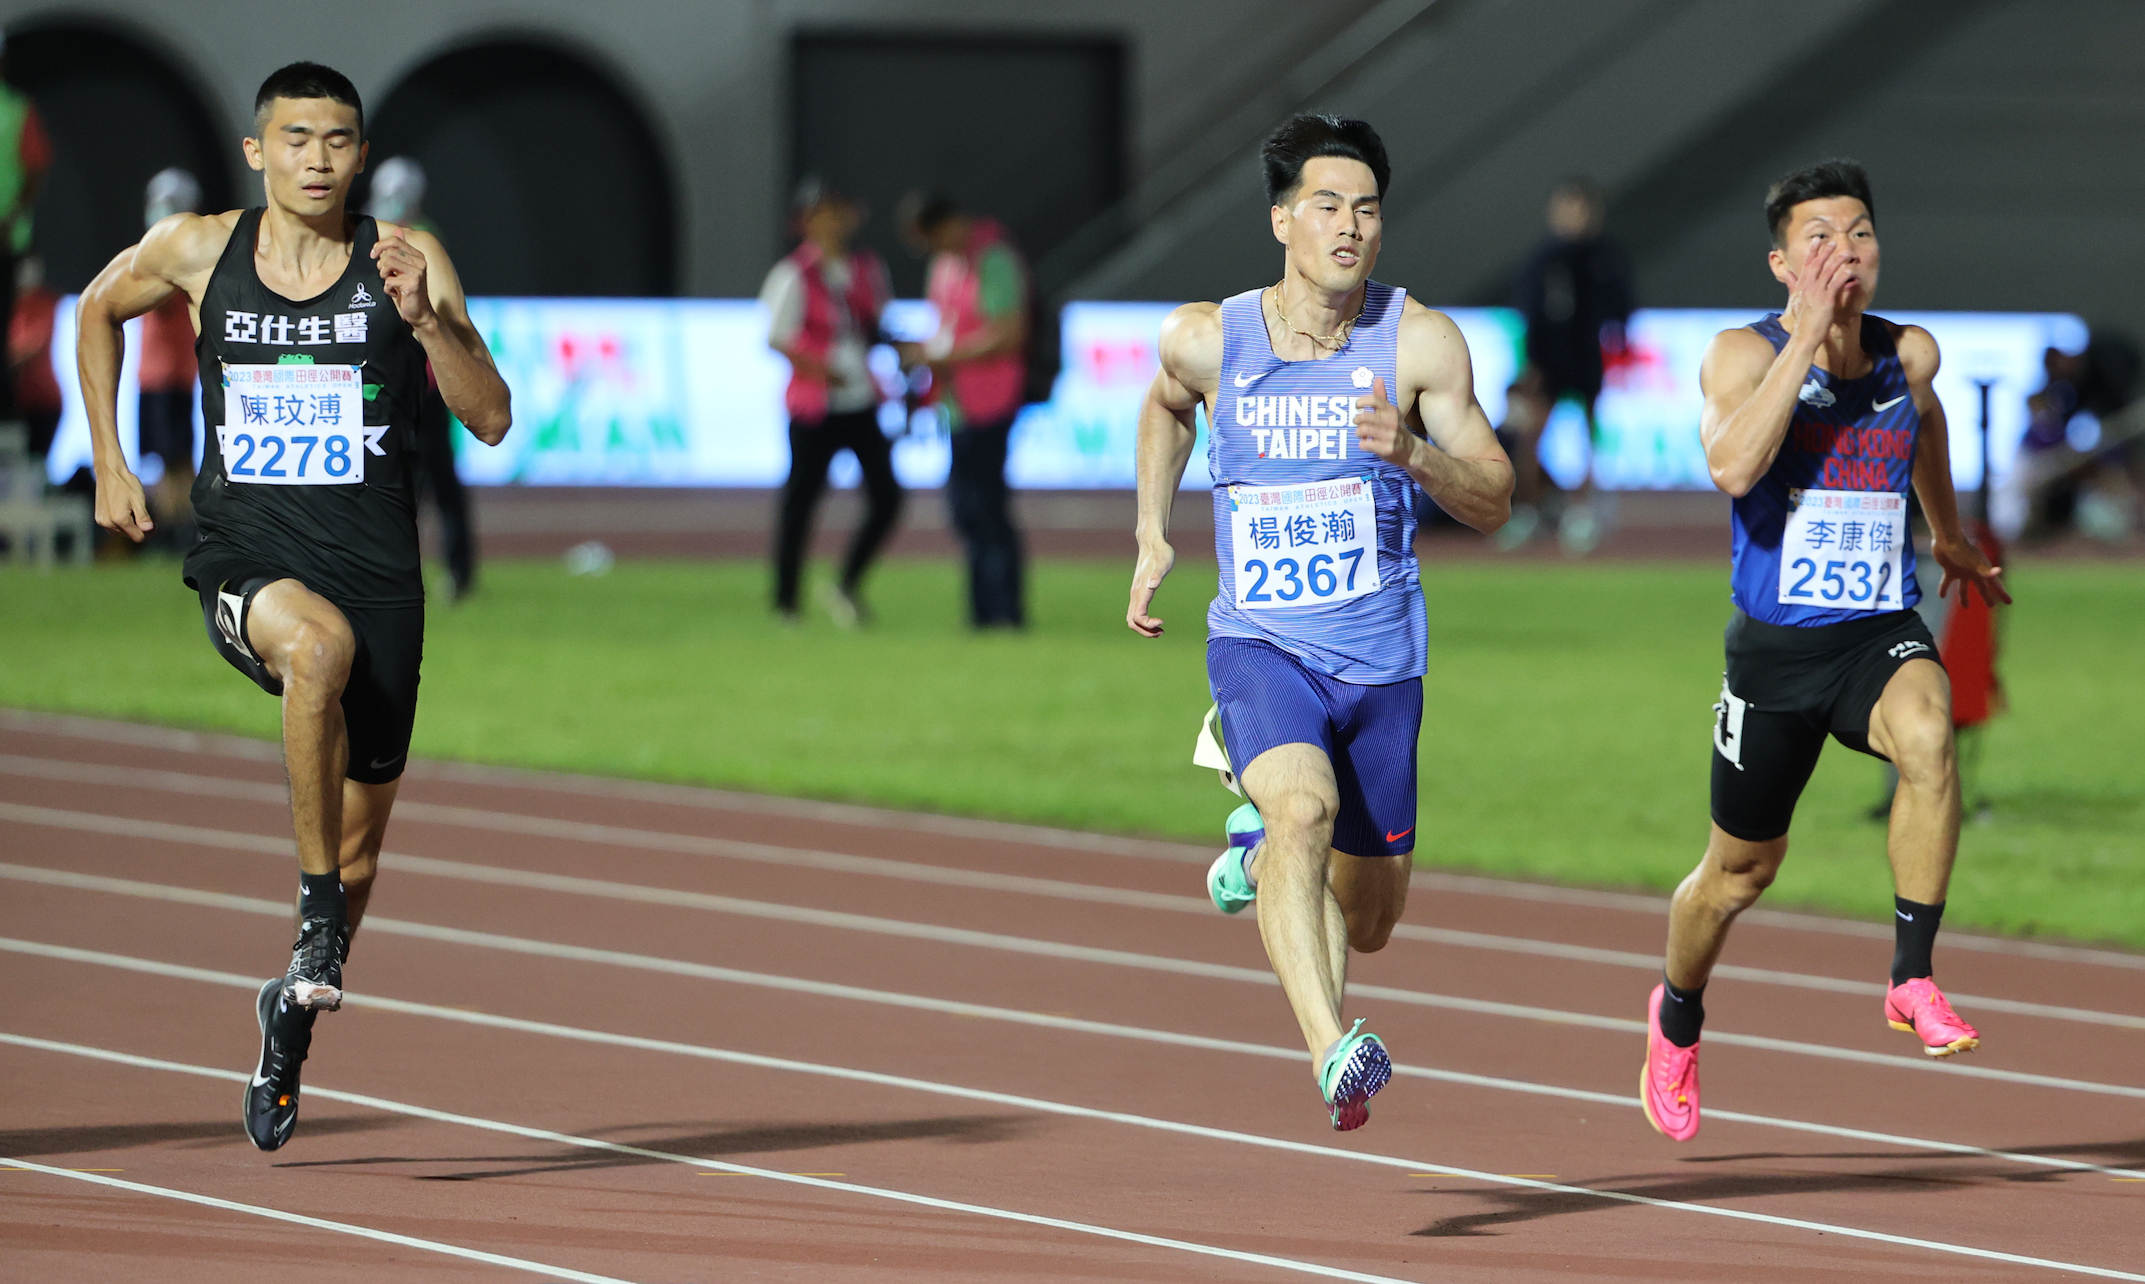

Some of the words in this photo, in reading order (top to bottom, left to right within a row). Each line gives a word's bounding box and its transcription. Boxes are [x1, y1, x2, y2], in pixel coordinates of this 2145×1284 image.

[224, 310, 369, 346] 亞仕生醫
[241, 393, 343, 427] 陳玟溥
[231, 433, 352, 477] 2278
[1251, 429, 1348, 460] TAIPEI
[1794, 422, 1855, 456] HONG
[1857, 428, 1911, 460] KONG
[1823, 456, 1891, 491] CHINA
[1295, 501, 1337, 509] ATHLETICS
[1249, 509, 1355, 550] 楊俊瀚
[1805, 519, 1893, 553] 李康傑
[1244, 546, 1365, 602] 2367
[1789, 557, 1891, 602] 2532
